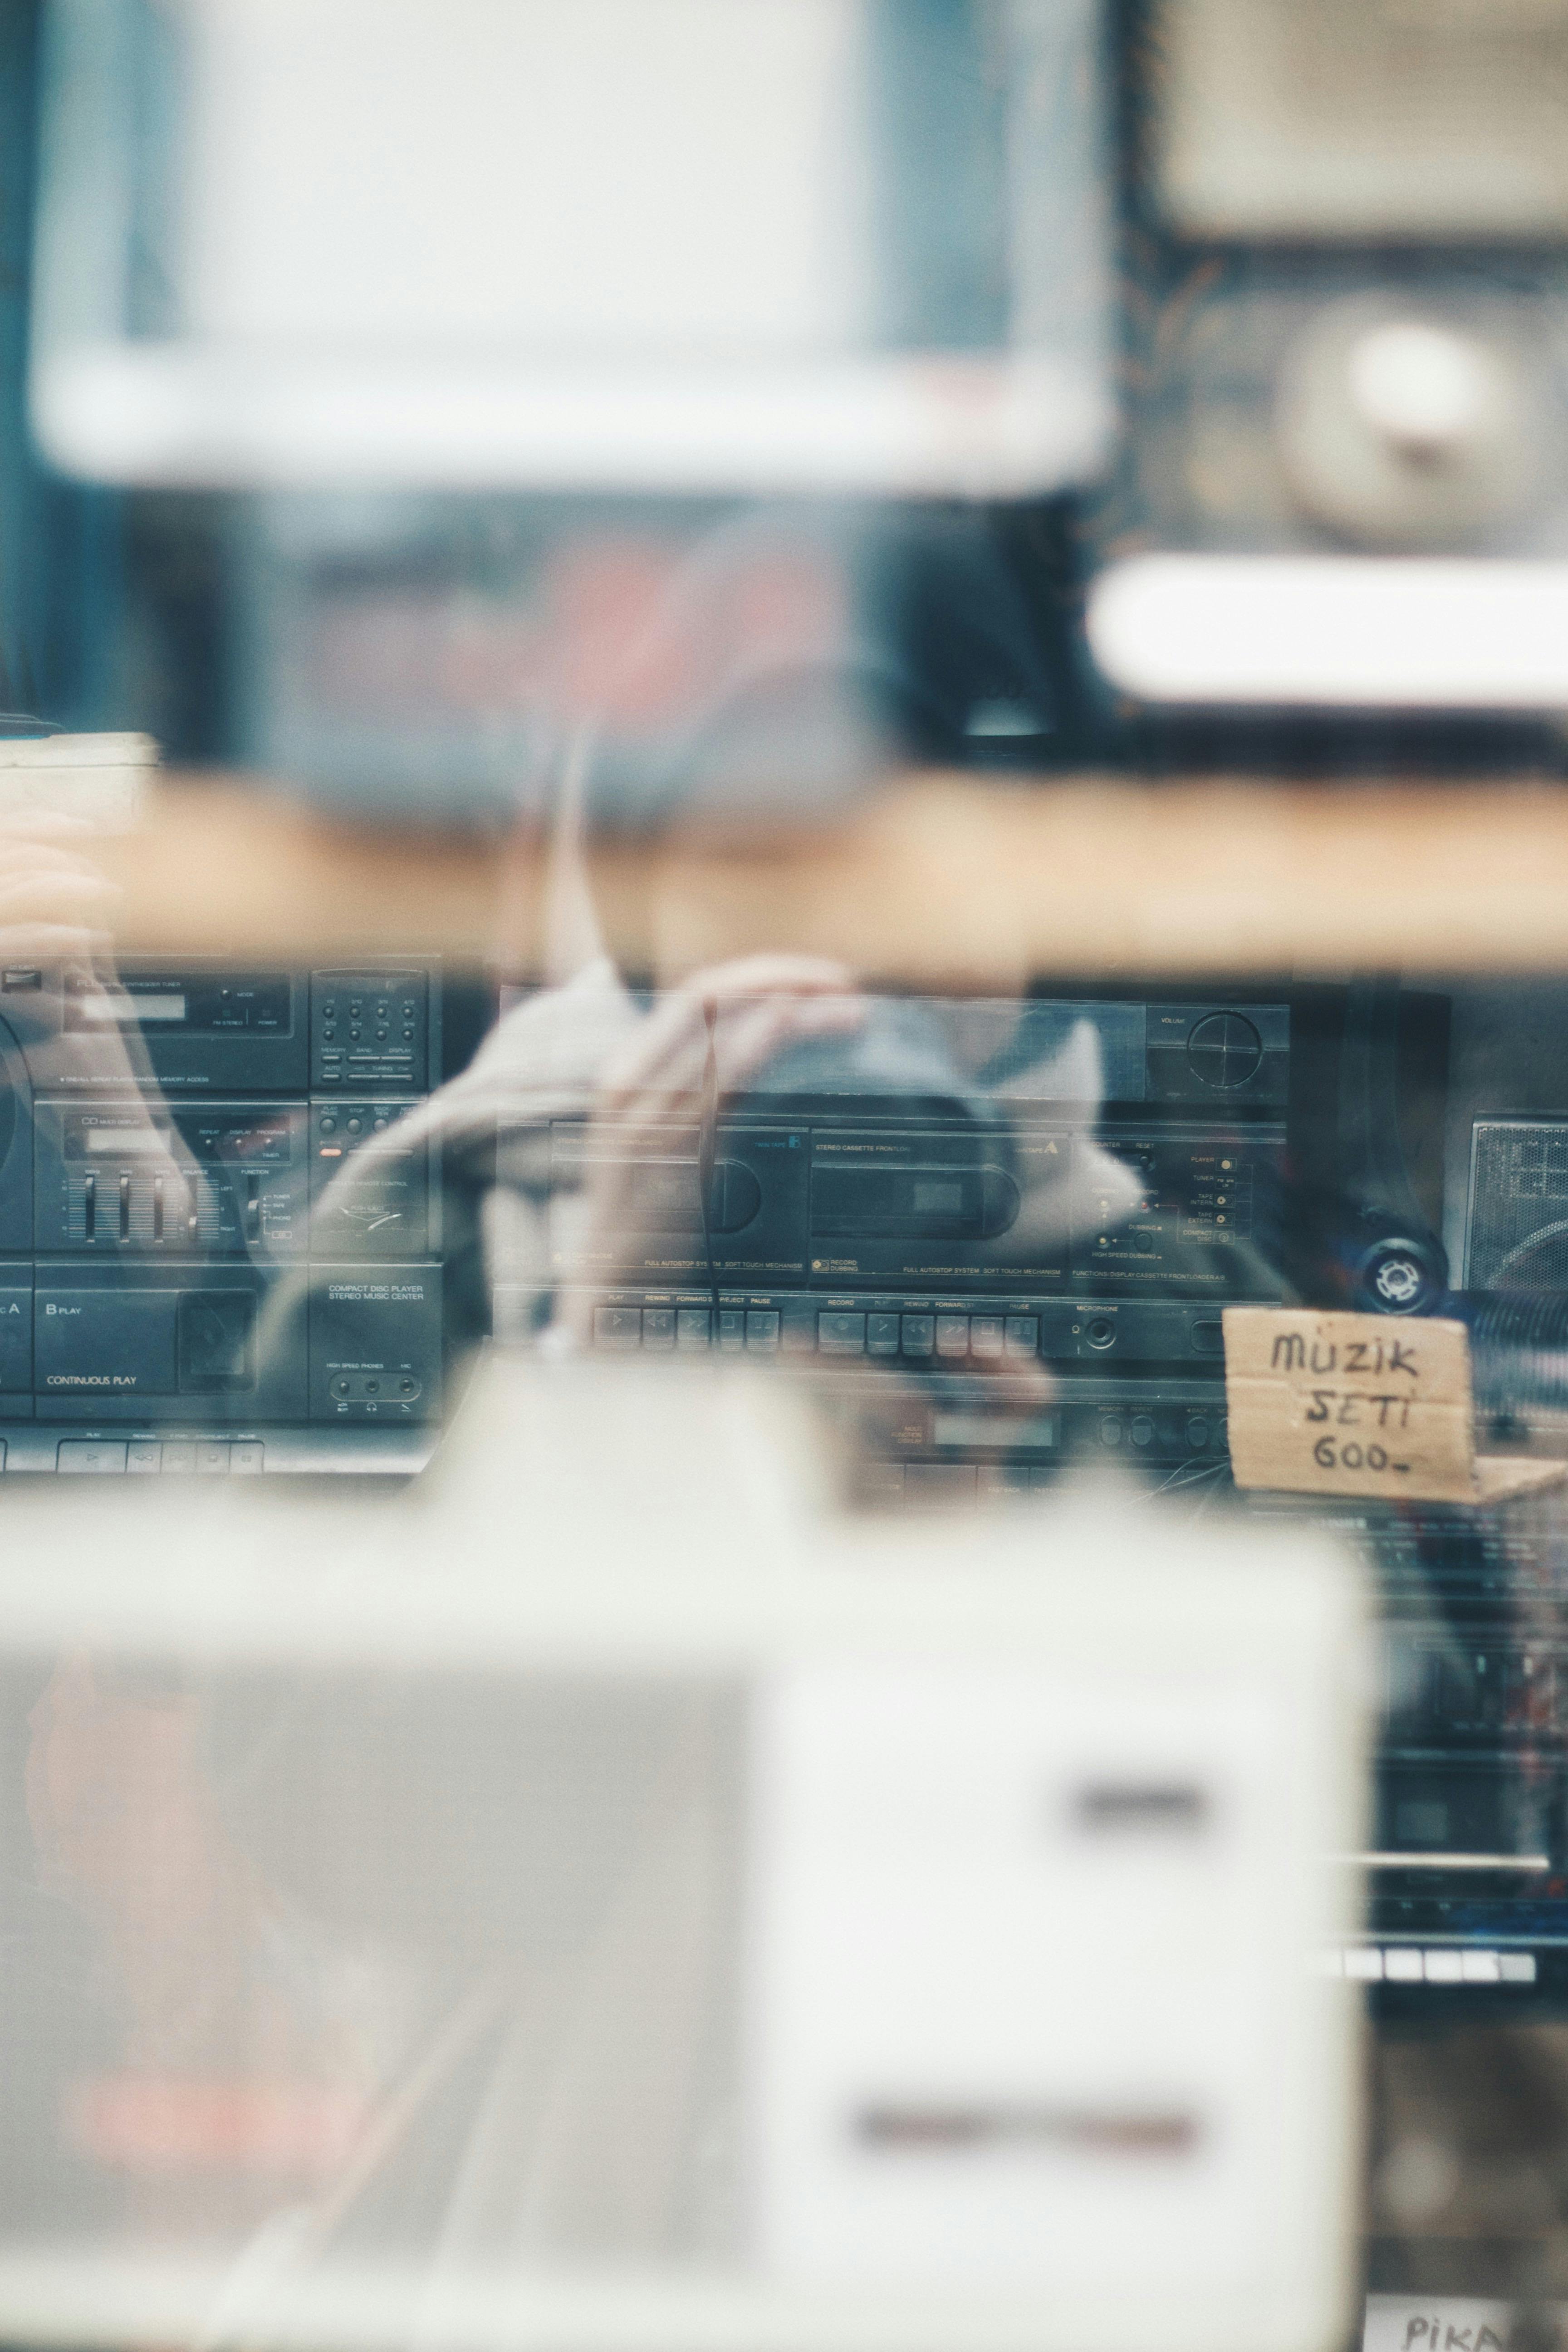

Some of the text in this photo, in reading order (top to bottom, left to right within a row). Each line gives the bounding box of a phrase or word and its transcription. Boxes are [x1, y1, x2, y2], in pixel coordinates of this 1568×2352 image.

[81, 1117, 98, 1125] CD
[1044, 1141, 1058, 1154] A
[9, 1303, 20, 1314] A
[46, 1303, 57, 1315] B
[47, 1376, 137, 1385] CONTINUOUS PLAY
